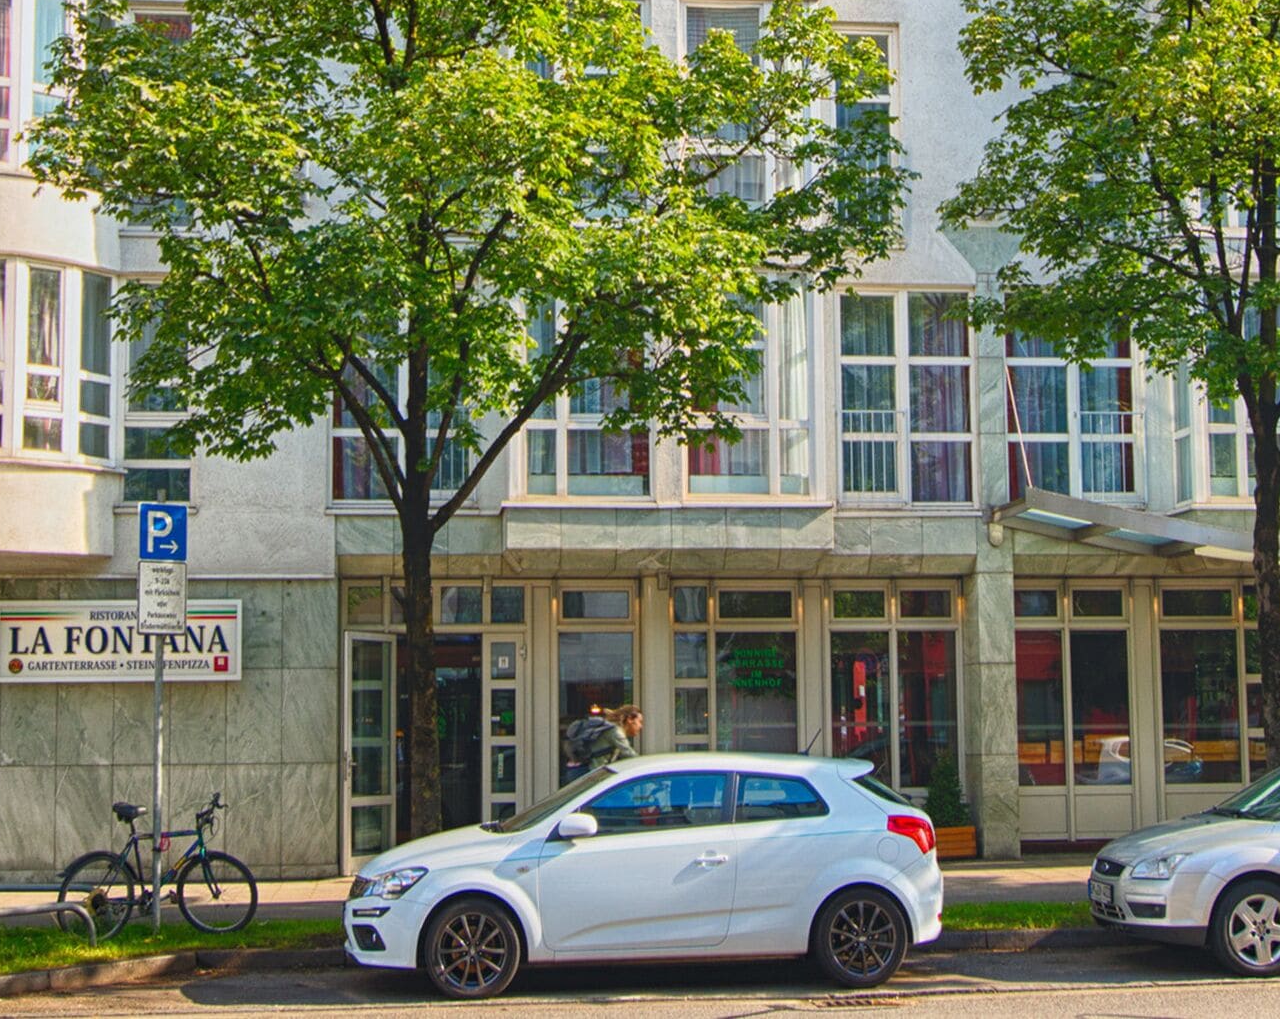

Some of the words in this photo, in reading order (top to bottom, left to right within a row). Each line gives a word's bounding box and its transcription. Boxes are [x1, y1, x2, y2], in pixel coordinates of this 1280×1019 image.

[147, 510, 173, 553] P
[89, 611, 138, 621] RISTORAN
[9, 626, 52, 655] LA
[64, 625, 230, 655] FONTANA
[27, 660, 117, 671] GARTENTERRASSE
[126, 660, 210, 671] STEINFENPIZZA
